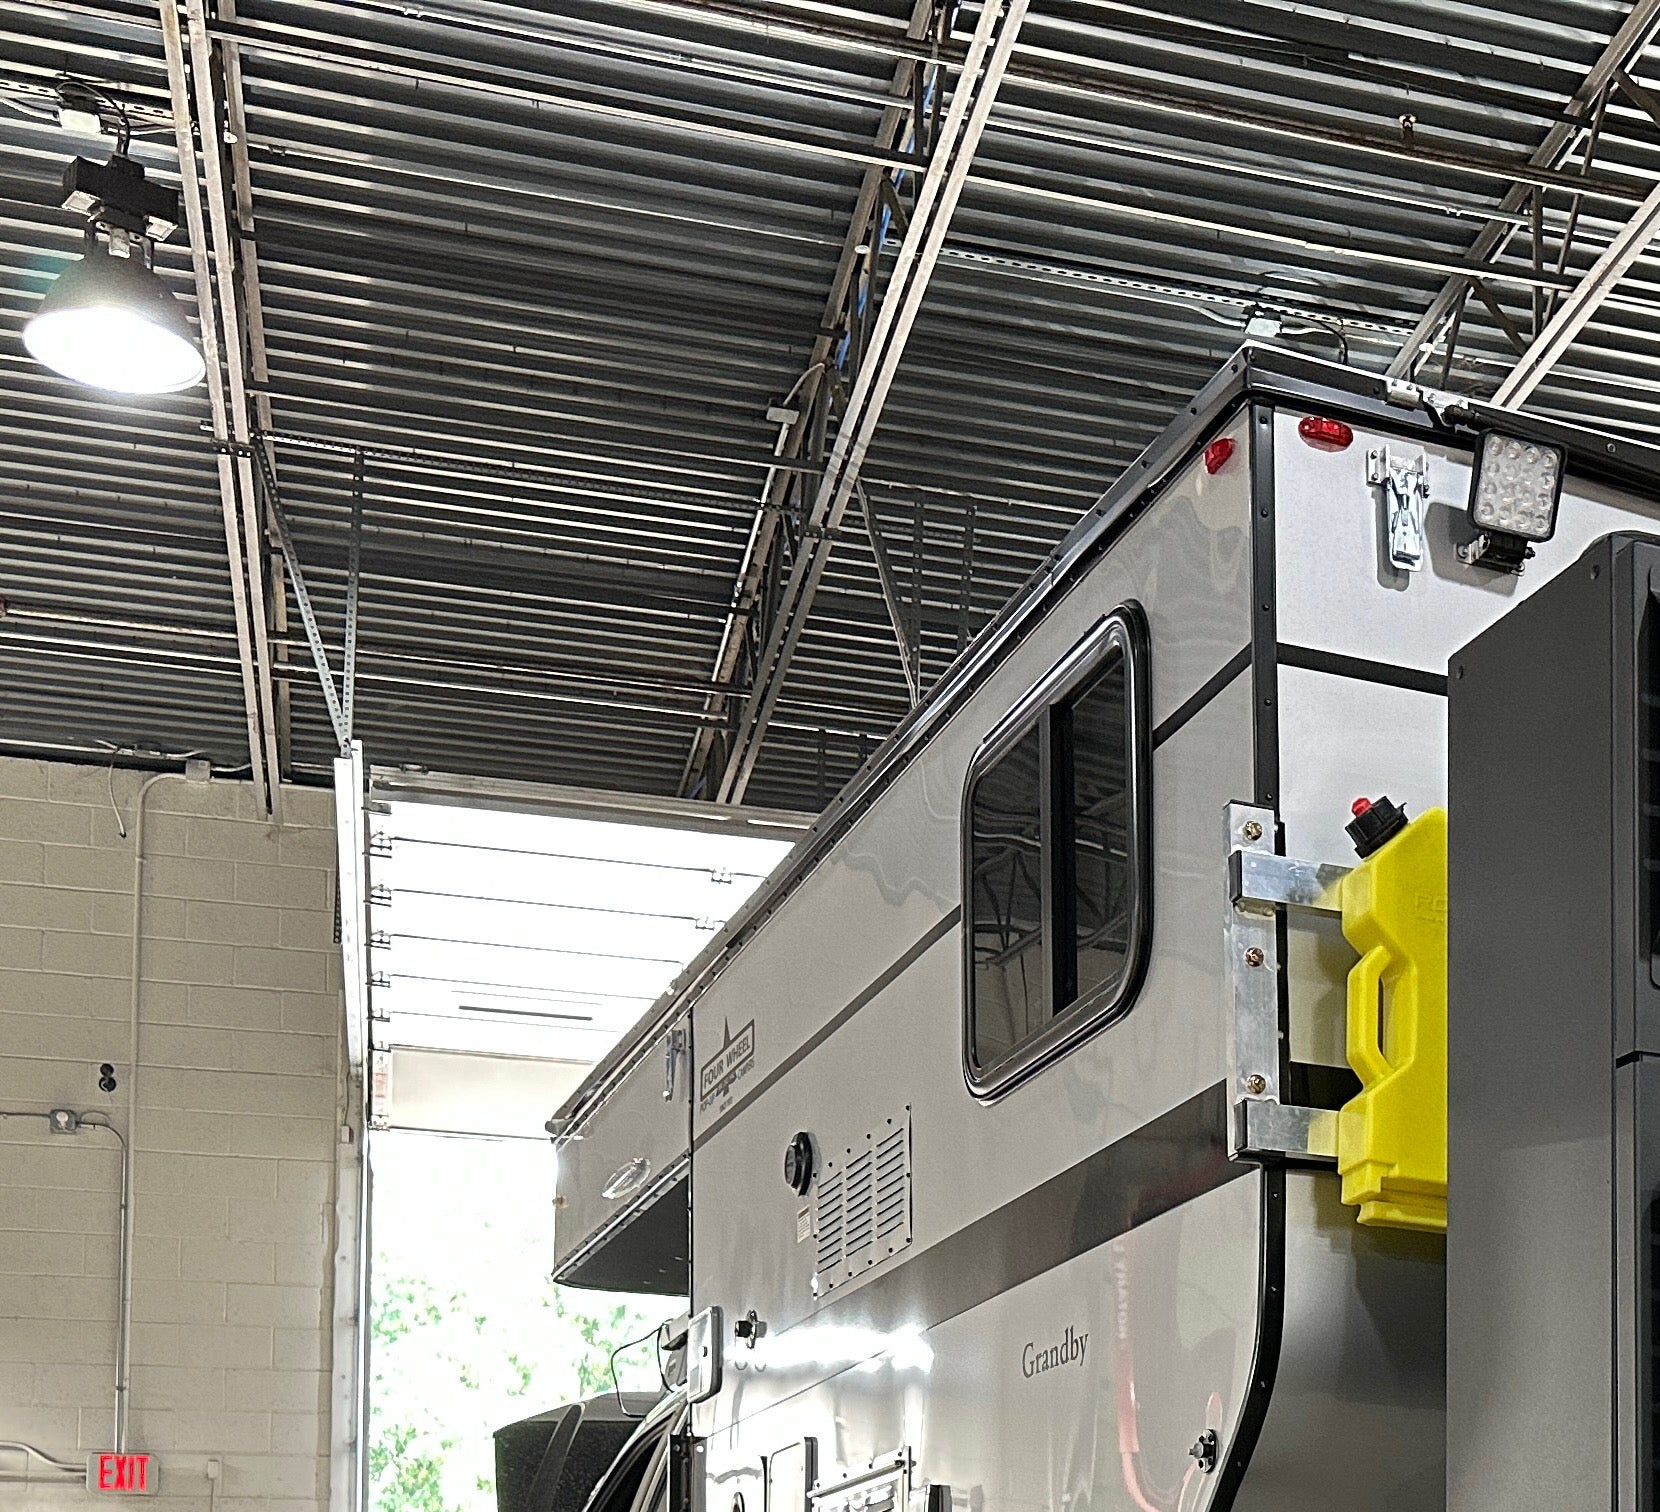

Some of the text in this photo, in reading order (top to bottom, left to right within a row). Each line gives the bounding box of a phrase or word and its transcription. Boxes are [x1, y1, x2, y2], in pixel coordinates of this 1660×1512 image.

[703, 1058, 725, 1090] FOUR
[725, 1034, 751, 1069] WHEEL
[1022, 1324, 1089, 1379] Grandby
[98, 1454, 150, 1491] EXIT
